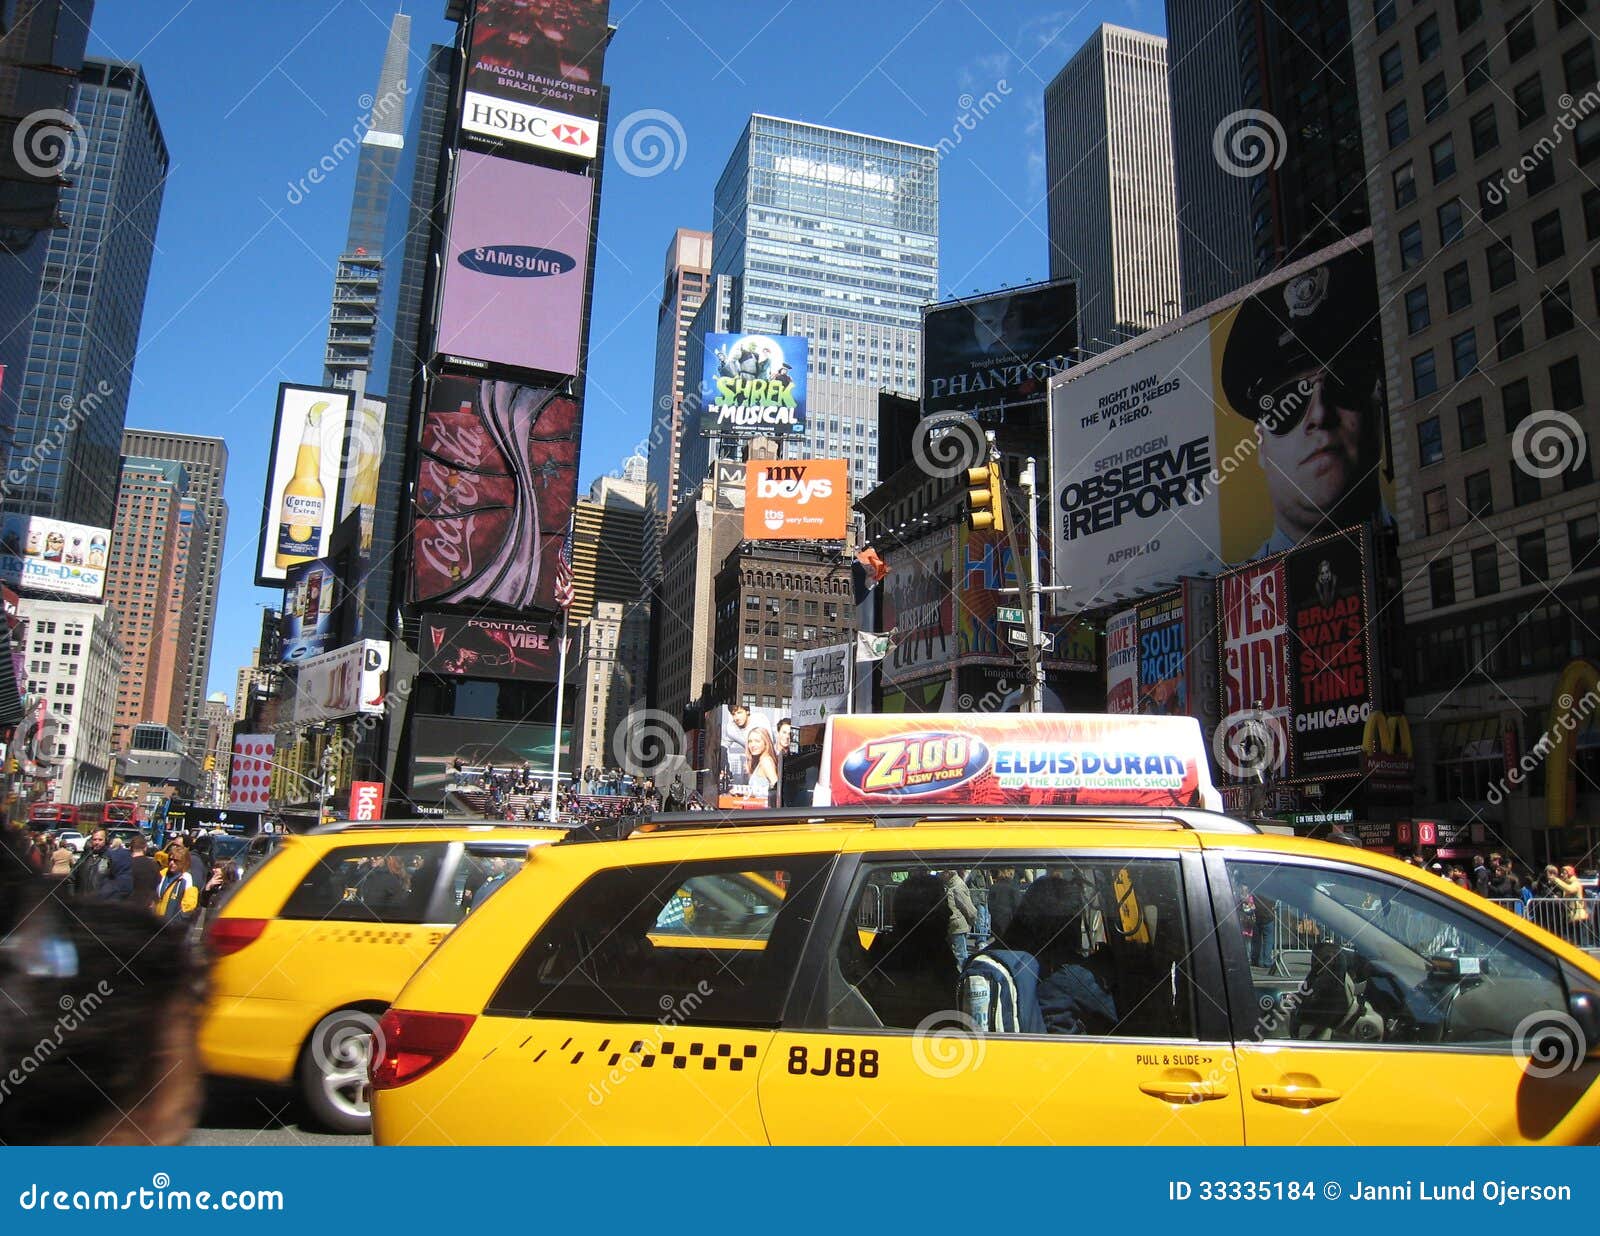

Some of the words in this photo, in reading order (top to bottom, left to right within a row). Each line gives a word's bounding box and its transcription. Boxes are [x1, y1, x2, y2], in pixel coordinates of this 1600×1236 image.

[475, 61, 525, 80] AMAZON
[527, 73, 598, 97] RAINFOREST
[497, 77, 539, 93] BRAZIL
[472, 103, 548, 138] HSBC
[474, 248, 561, 276] SAMSUNG
[713, 374, 797, 408] SHREK
[1081, 411, 1100, 428] THE
[1101, 397, 1139, 419] WORLD
[1142, 378, 1180, 402] NEEDS
[1099, 387, 1128, 409] RIGHT
[1131, 375, 1160, 395] NOW,
[717, 404, 798, 425] MUSICAL
[1108, 418, 1117, 430] A
[1094, 453, 1124, 473] SETH
[1126, 435, 1169, 461] ROGEN
[766, 466, 807, 492] my
[1059, 436, 1211, 512] OBSERVE
[757, 472, 832, 504] boys
[286, 496, 322, 508] Corona
[293, 507, 316, 515] Extra
[1069, 466, 1212, 540] REPORT
[764, 510, 784, 519] tbs
[803, 516, 824, 524] funny
[1107, 545, 1142, 566] APRIL
[1145, 539, 1161, 555] 10
[1005, 610, 1014, 620] 46
[1296, 594, 1360, 627] BROAD
[467, 620, 537, 633] PONTIAC
[1299, 615, 1361, 646] WAY'S
[508, 632, 550, 650] VIBE
[803, 650, 845, 677] THE
[1300, 638, 1361, 674] SURE
[983, 668, 1015, 681] Tonight
[1301, 663, 1365, 704] THING
[812, 681, 844, 698] NEAR
[1296, 702, 1370, 732] CHICAGO
[863, 734, 971, 791] Z100
[995, 750, 1076, 775] ELVIS
[1081, 750, 1186, 776] DURAN
[907, 773, 932, 785] NEW
[936, 768, 963, 779] YORK
[1001, 777, 1023, 787] AND
[1029, 777, 1049, 787] THE
[1054, 777, 1081, 787] Z100
[1085, 777, 1141, 788] MORNING
[1144, 777, 1182, 788] SHOW
[357, 786, 379, 820] tkts
[788, 1046, 879, 1078] 8J88
[1136, 1055, 1159, 1065] PULL
[1163, 1055, 1170, 1065] &
[1173, 1055, 1200, 1065] SLIDE
